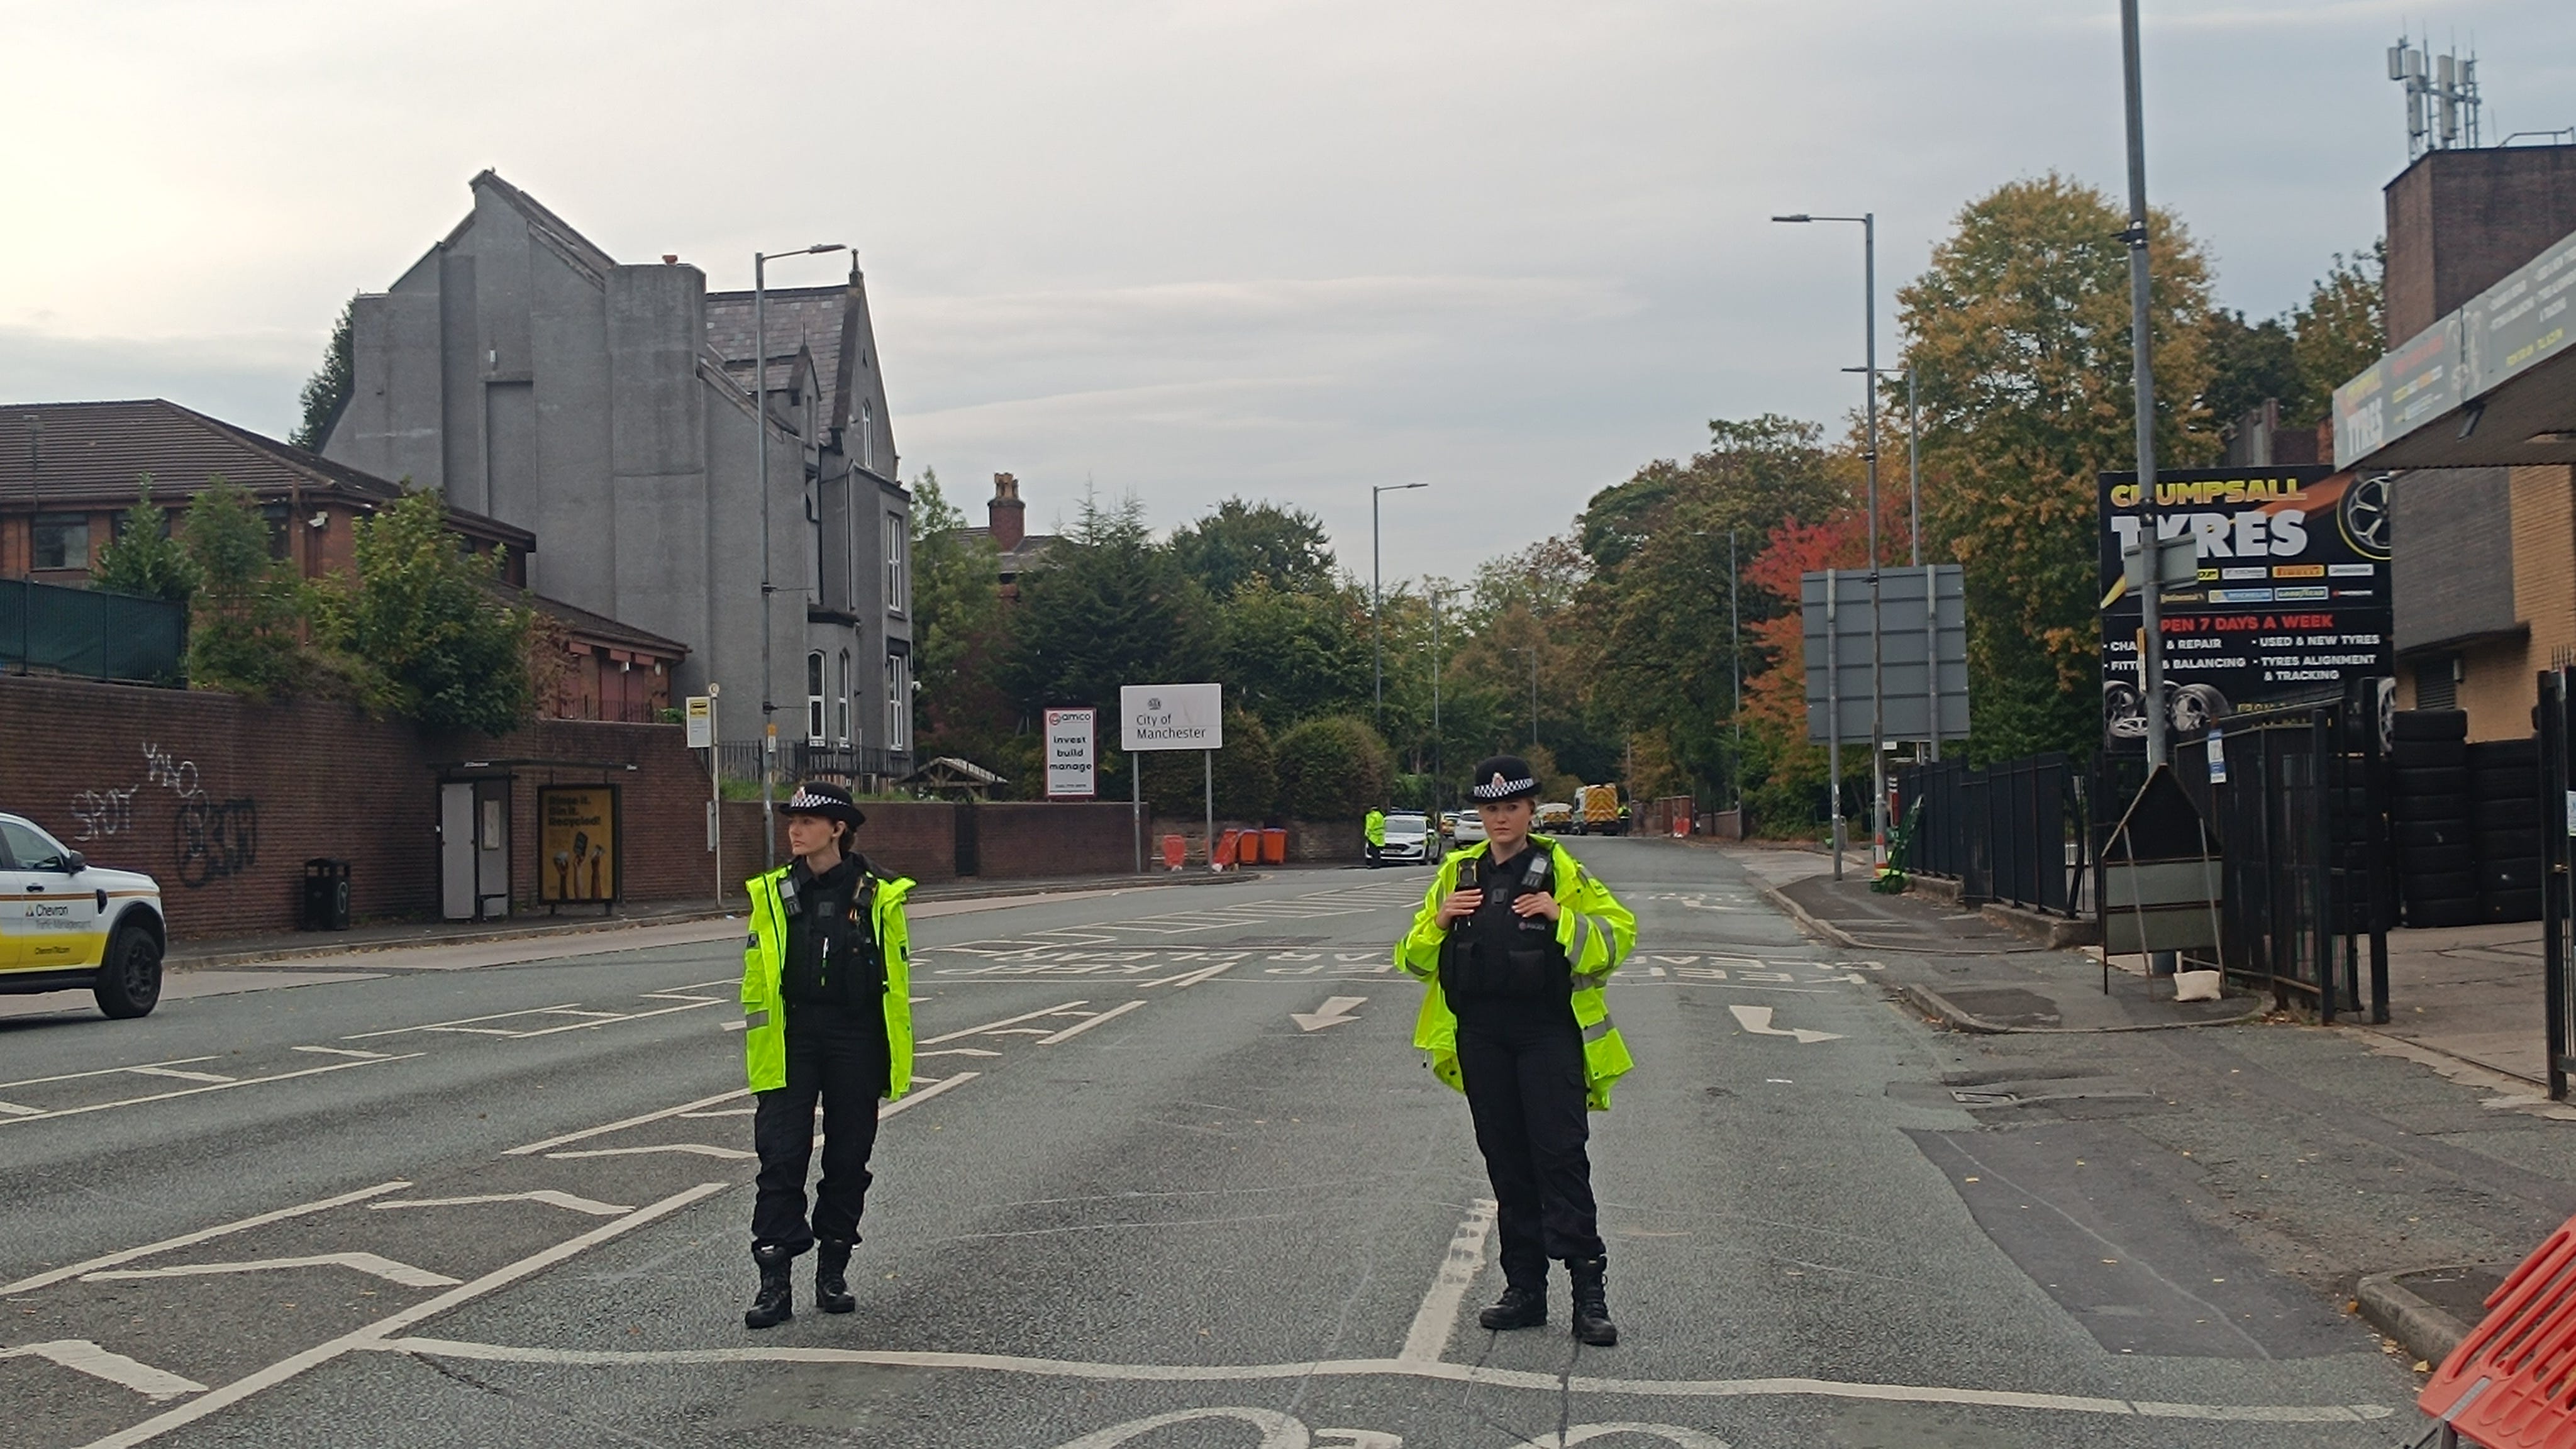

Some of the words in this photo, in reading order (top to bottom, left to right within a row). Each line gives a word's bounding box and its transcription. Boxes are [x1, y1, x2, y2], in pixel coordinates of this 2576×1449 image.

[2161, 619, 2194, 631] PEN
[2201, 618, 2211, 630] 7
[2215, 616, 2258, 631] DAYS
[2263, 616, 2277, 629] A
[2281, 614, 2333, 628] WEEK
[2166, 640, 2175, 650] &
[2178, 638, 2223, 649] REPAIR
[2260, 636, 2292, 647] USED
[2296, 636, 2304, 646] &
[2307, 635, 2338, 645] NEW
[2341, 634, 2380, 645] TYRES
[2172, 657, 2246, 669] BALANCING
[2260, 657, 2300, 667] TYRES
[2302, 654, 2377, 665] ALIGNMENT
[2264, 671, 2273, 681] &
[2276, 670, 2340, 680] TRACKING
[1136, 714, 1157, 727] City
[1160, 713, 1172, 725] of
[1053, 735, 1086, 743] invest
[1137, 727, 1206, 740] Manchester
[1057, 748, 1084, 757] build
[1049, 763, 1092, 773] manage
[36, 904, 69, 917] Chevron
